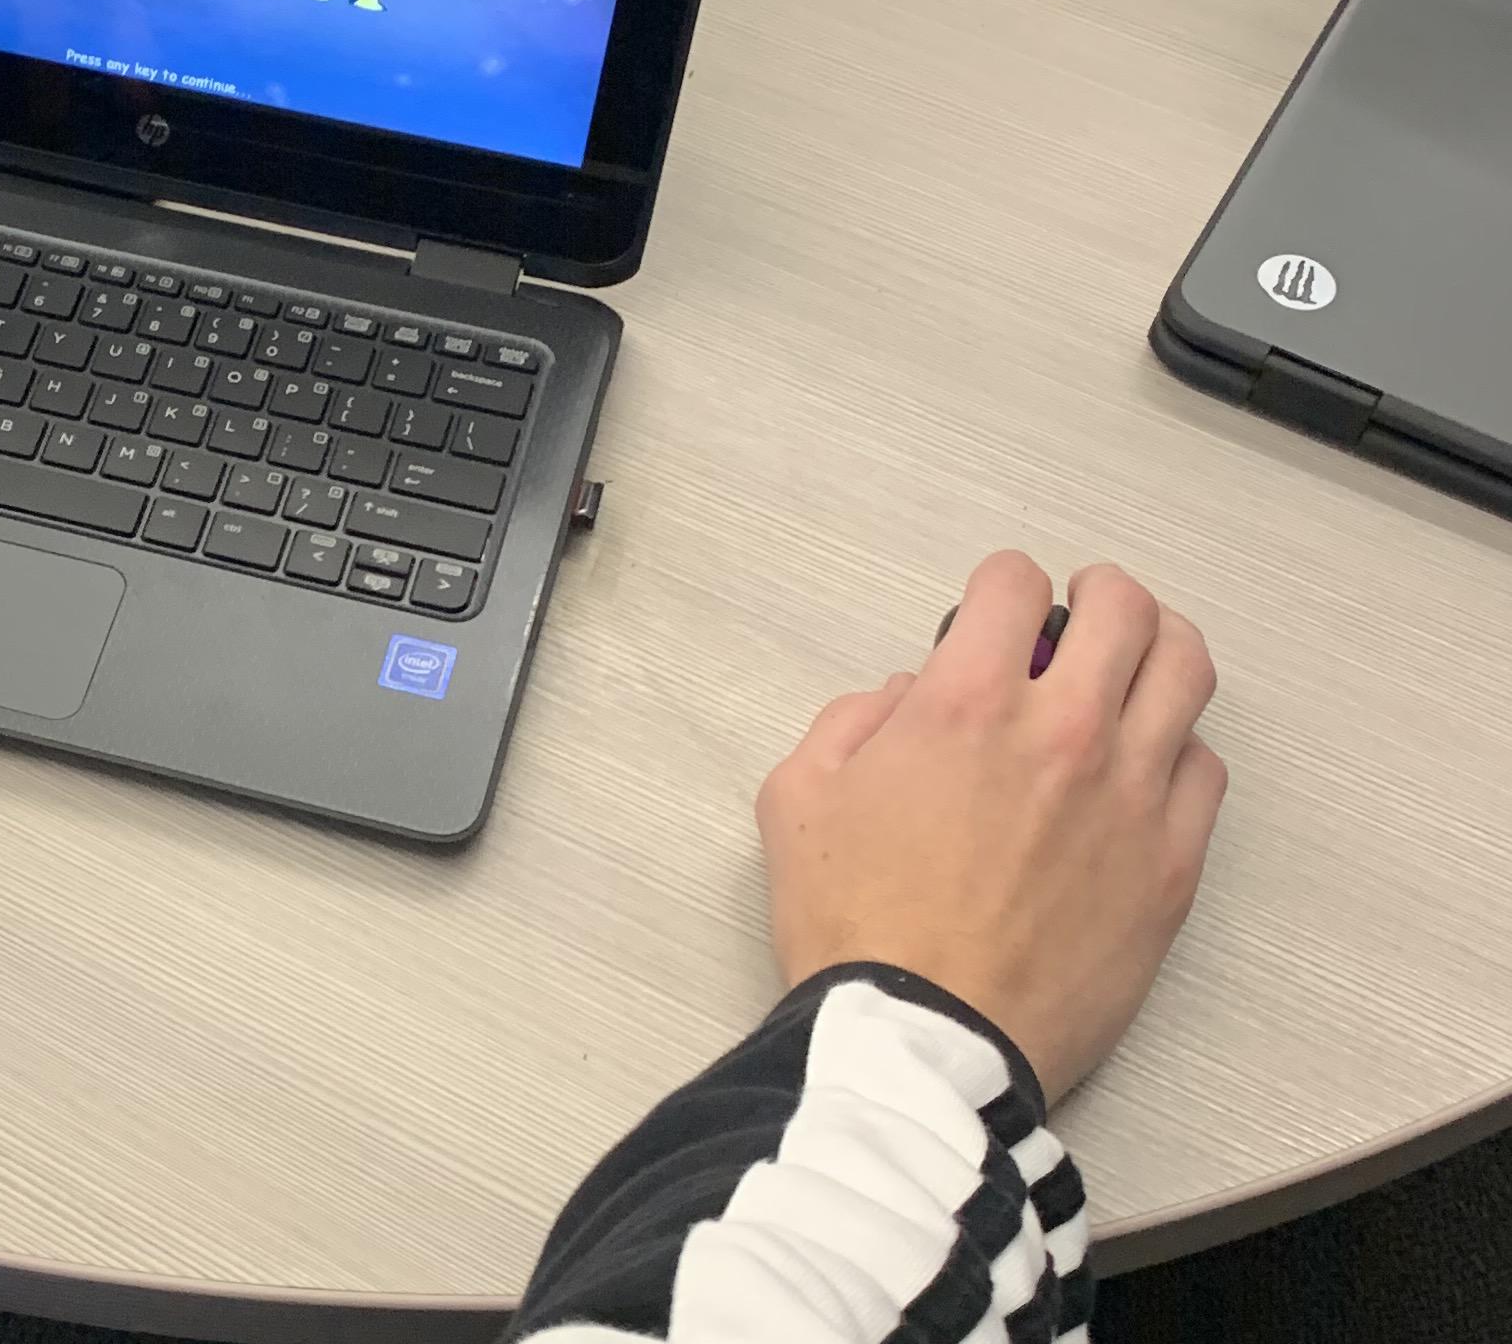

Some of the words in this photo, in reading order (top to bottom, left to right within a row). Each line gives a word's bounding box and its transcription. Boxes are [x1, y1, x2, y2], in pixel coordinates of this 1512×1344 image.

[66, 47, 101, 67] Press
[106, 58, 129, 76] any
[134, 61, 158, 81] key
[162, 69, 177, 83] to
[34, 295, 45, 306] 6
[91, 307, 103, 318] 7
[149, 320, 161, 332] 8
[53, 331, 67, 344] Y
[207, 332, 219, 344] 9
[109, 344, 123, 357] U
[167, 357, 175, 369] I
[227, 371, 242, 384] O
[47, 380, 62, 393] H
[285, 383, 299, 395] P
[105, 393, 117, 405] J
[164, 406, 179, 420] K
[0, 419, 14, 432] B
[224, 420, 236, 433] L
[59, 432, 75, 446] N
[119, 446, 136, 460] M
[404, 655, 435, 669] intel
